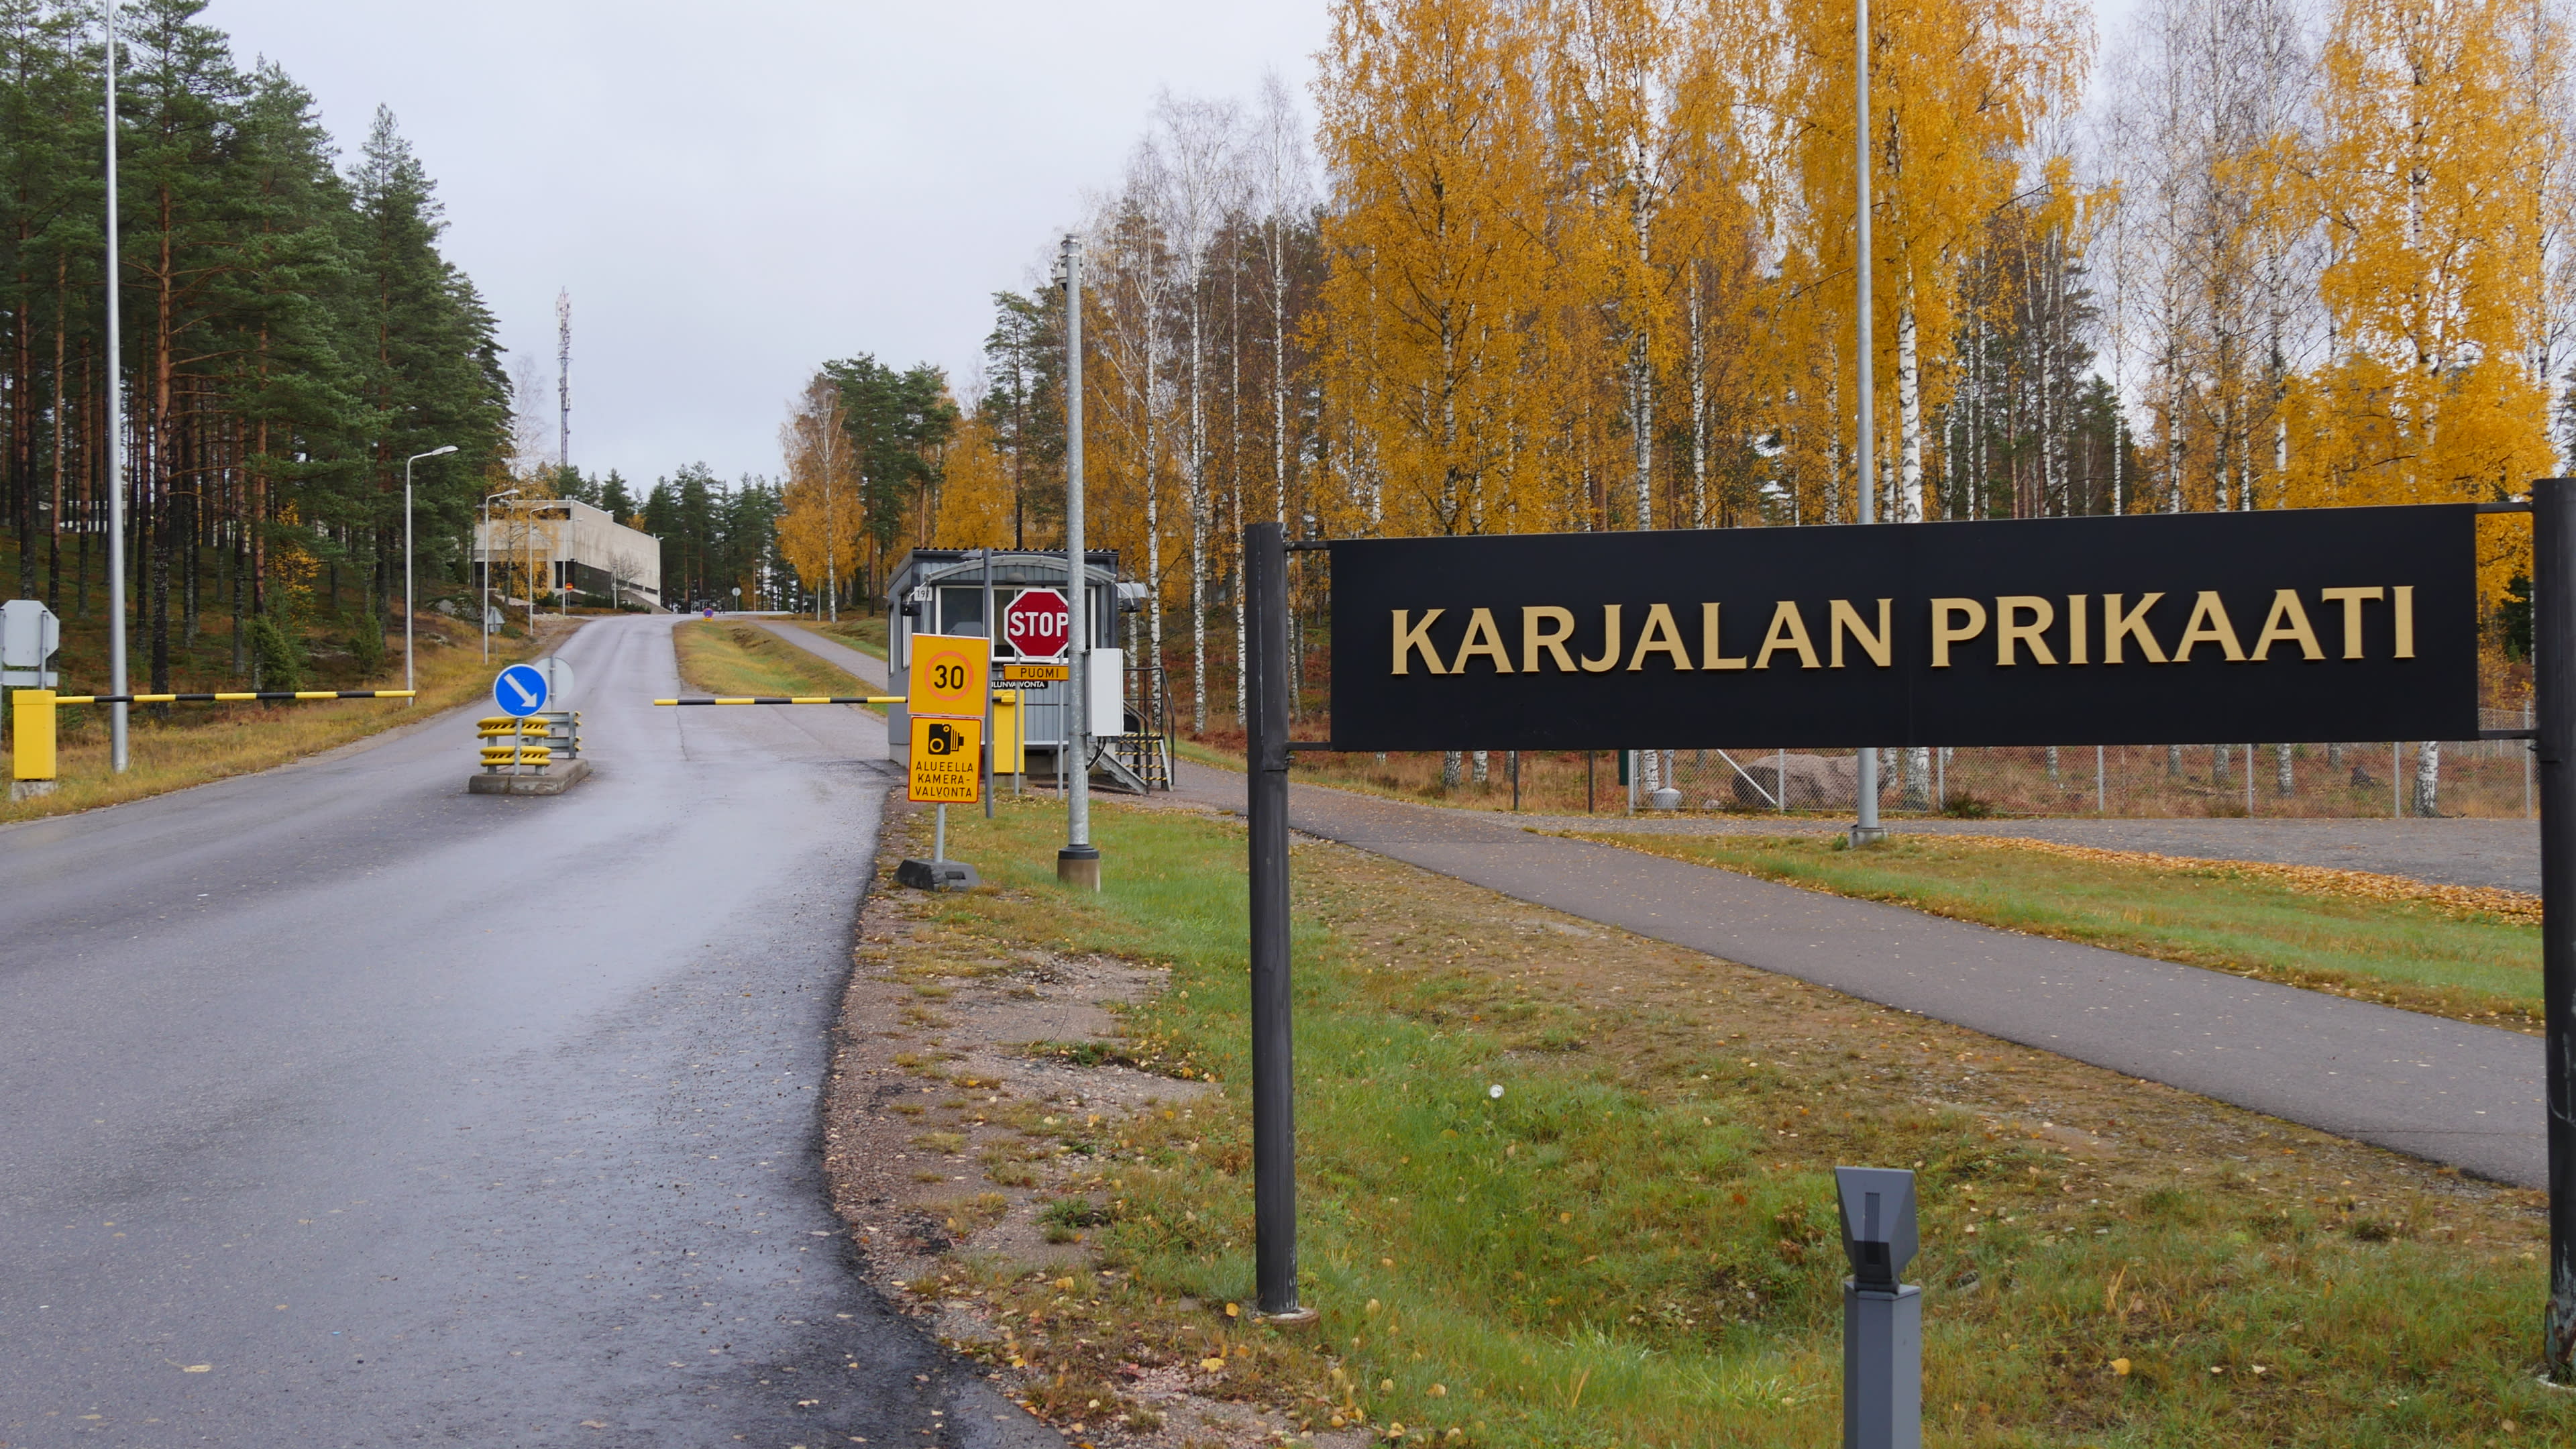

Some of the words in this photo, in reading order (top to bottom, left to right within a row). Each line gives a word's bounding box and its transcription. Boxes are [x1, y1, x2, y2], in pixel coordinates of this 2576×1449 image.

[1010, 611, 1068, 637] STOP
[1391, 598, 1893, 675] KARJALAN
[1930, 586, 2416, 667] PRIKAATI
[934, 665, 964, 690] 30
[1020, 667, 1059, 678] PUOMI
[916, 761, 973, 772] ALUEELLA
[918, 773, 970, 784] KAMERA-
[915, 786, 971, 797] VALVONTA
